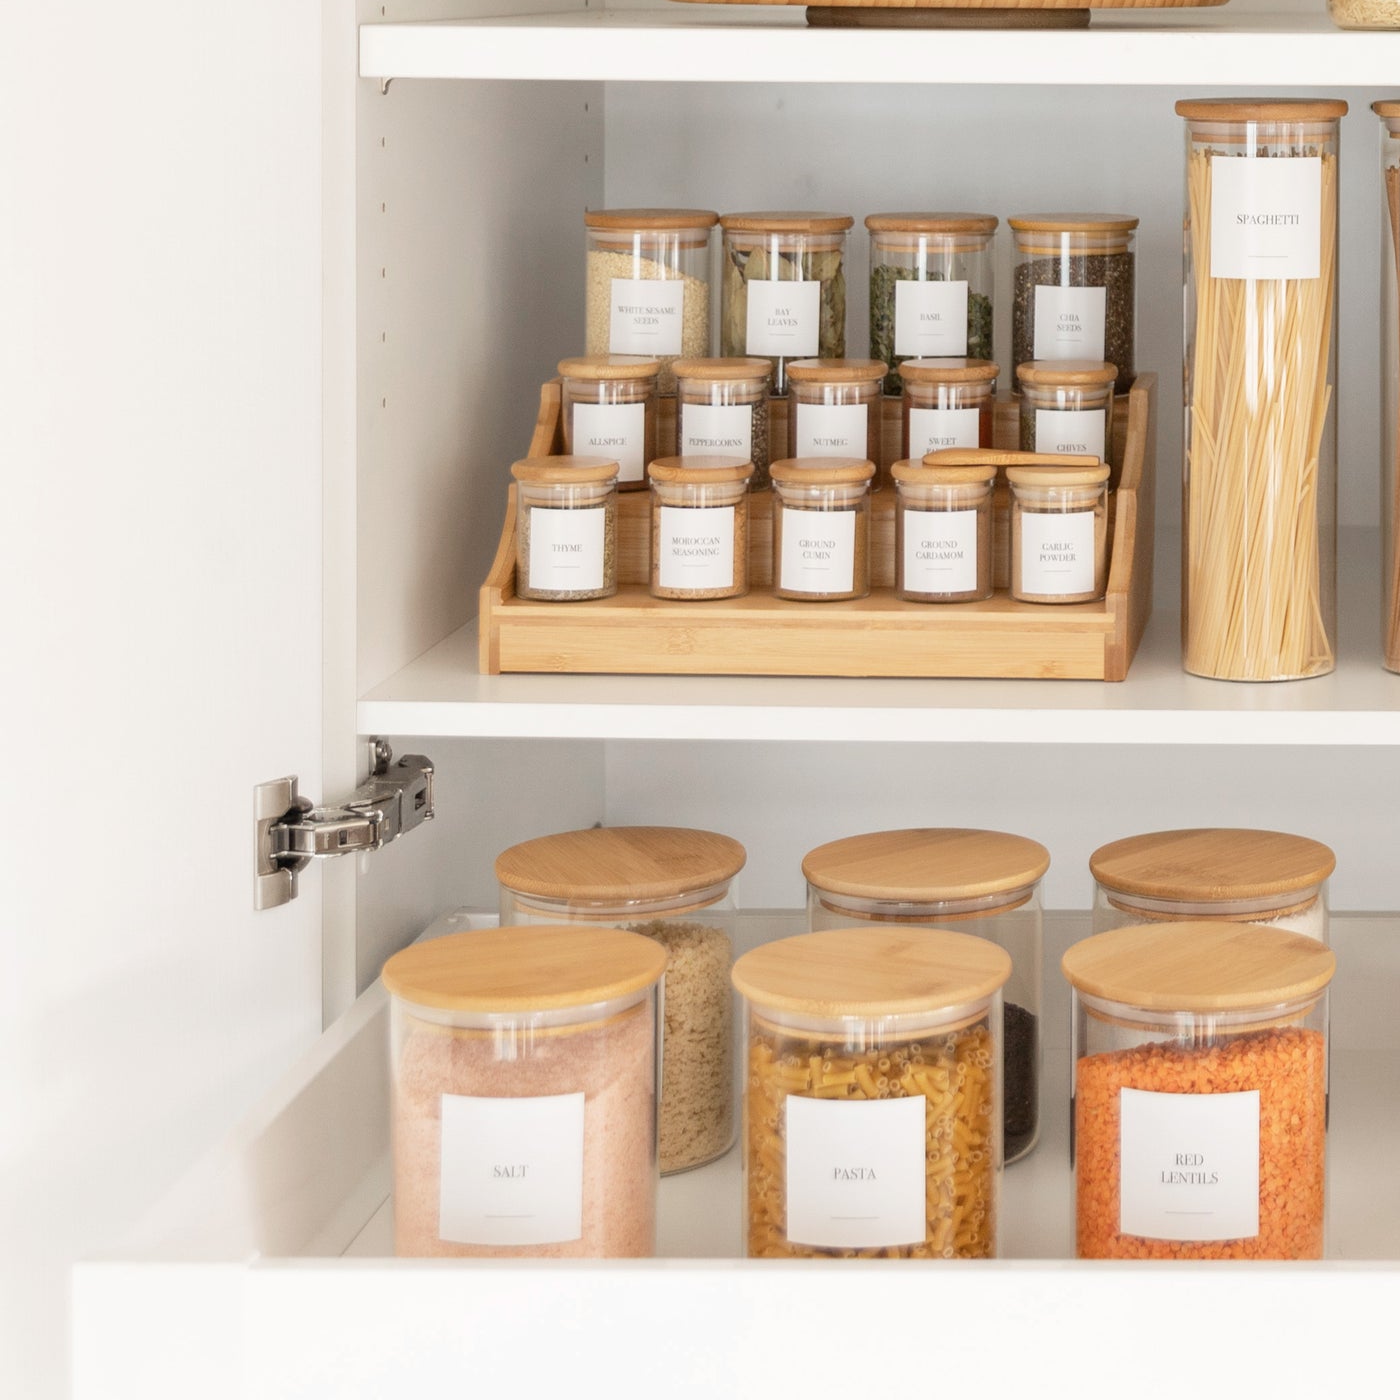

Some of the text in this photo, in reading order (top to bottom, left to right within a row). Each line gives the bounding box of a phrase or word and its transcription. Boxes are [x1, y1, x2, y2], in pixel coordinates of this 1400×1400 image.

[1236, 214, 1300, 226] SPAGHETTI
[775, 308, 790, 316] BAY
[632, 316, 659, 325] SEEDS
[920, 313, 942, 321] BASIL
[1059, 314, 1080, 322] CHIA
[767, 318, 798, 326] LEAVES
[1056, 323, 1082, 332] SEEDS
[588, 437, 627, 446] ALLSPICE
[688, 437, 743, 447] PEPPERCORNS
[813, 438, 848, 446] NUTMEG
[928, 437, 956, 445] SWEET
[1056, 444, 1087, 452] CHIVES
[672, 537, 720, 545] MOROCCAN
[799, 540, 835, 548] GROUND
[921, 540, 958, 549] GROUND
[552, 544, 582, 553] THYME
[672, 548, 720, 557] SEASONING
[802, 551, 831, 559] CUMIN
[916, 551, 964, 560] CARDAMOM
[1039, 553, 1076, 562] POWDER
[1175, 1153, 1204, 1166] RED
[493, 1165, 529, 1178] SALT
[833, 1167, 877, 1180] PASTA
[1161, 1171, 1219, 1184] LENTILS
